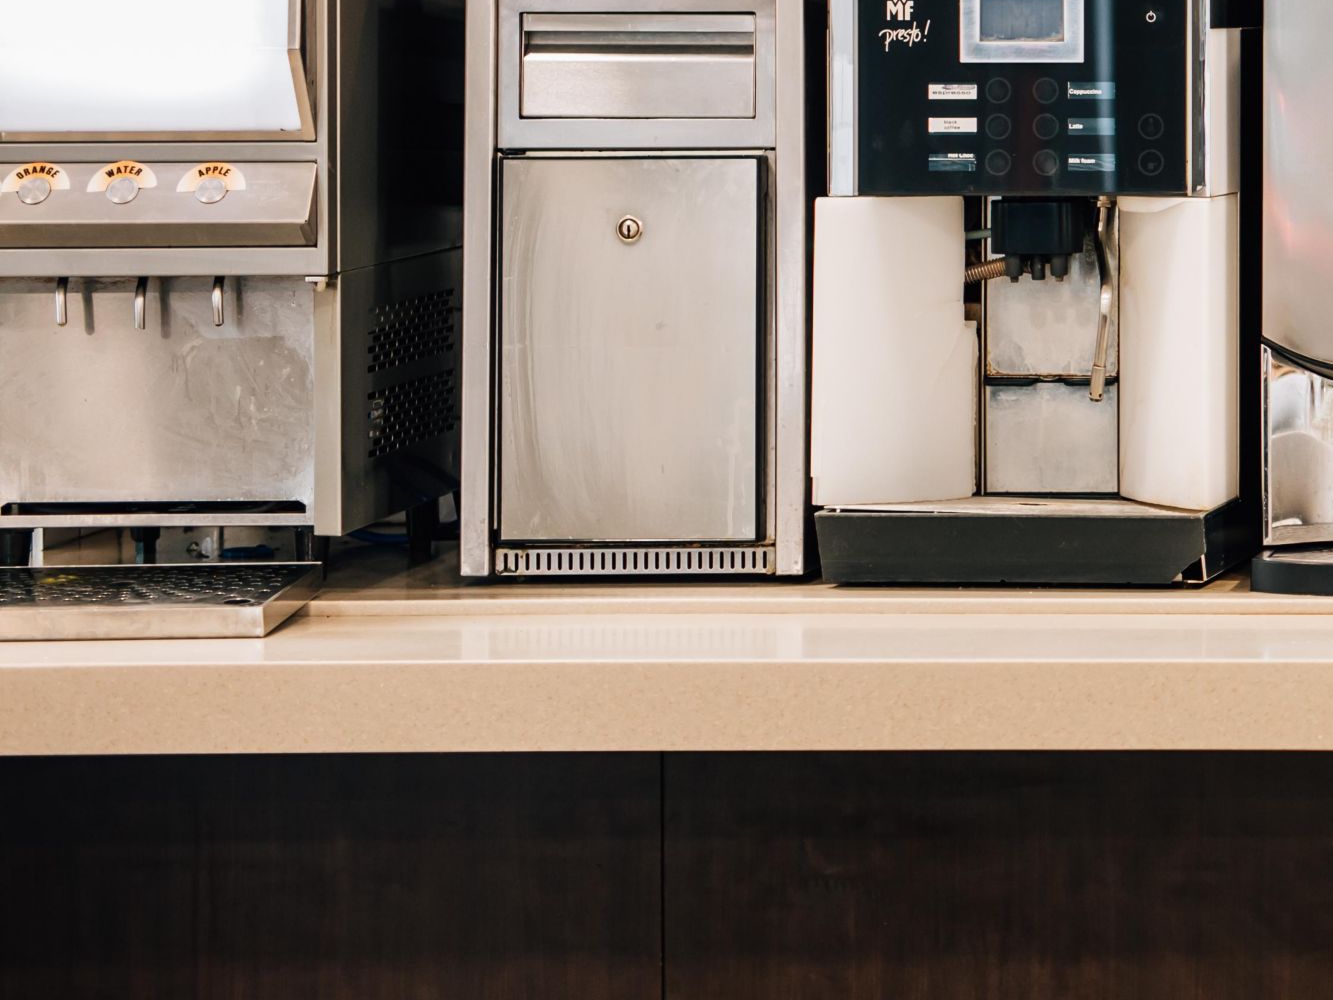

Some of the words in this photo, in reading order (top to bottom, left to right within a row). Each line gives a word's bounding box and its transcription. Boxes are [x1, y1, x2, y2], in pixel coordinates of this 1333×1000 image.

[16, 165, 60, 180] ORANGE
[105, 165, 143, 178] WATER
[198, 166, 232, 178] APPLE
